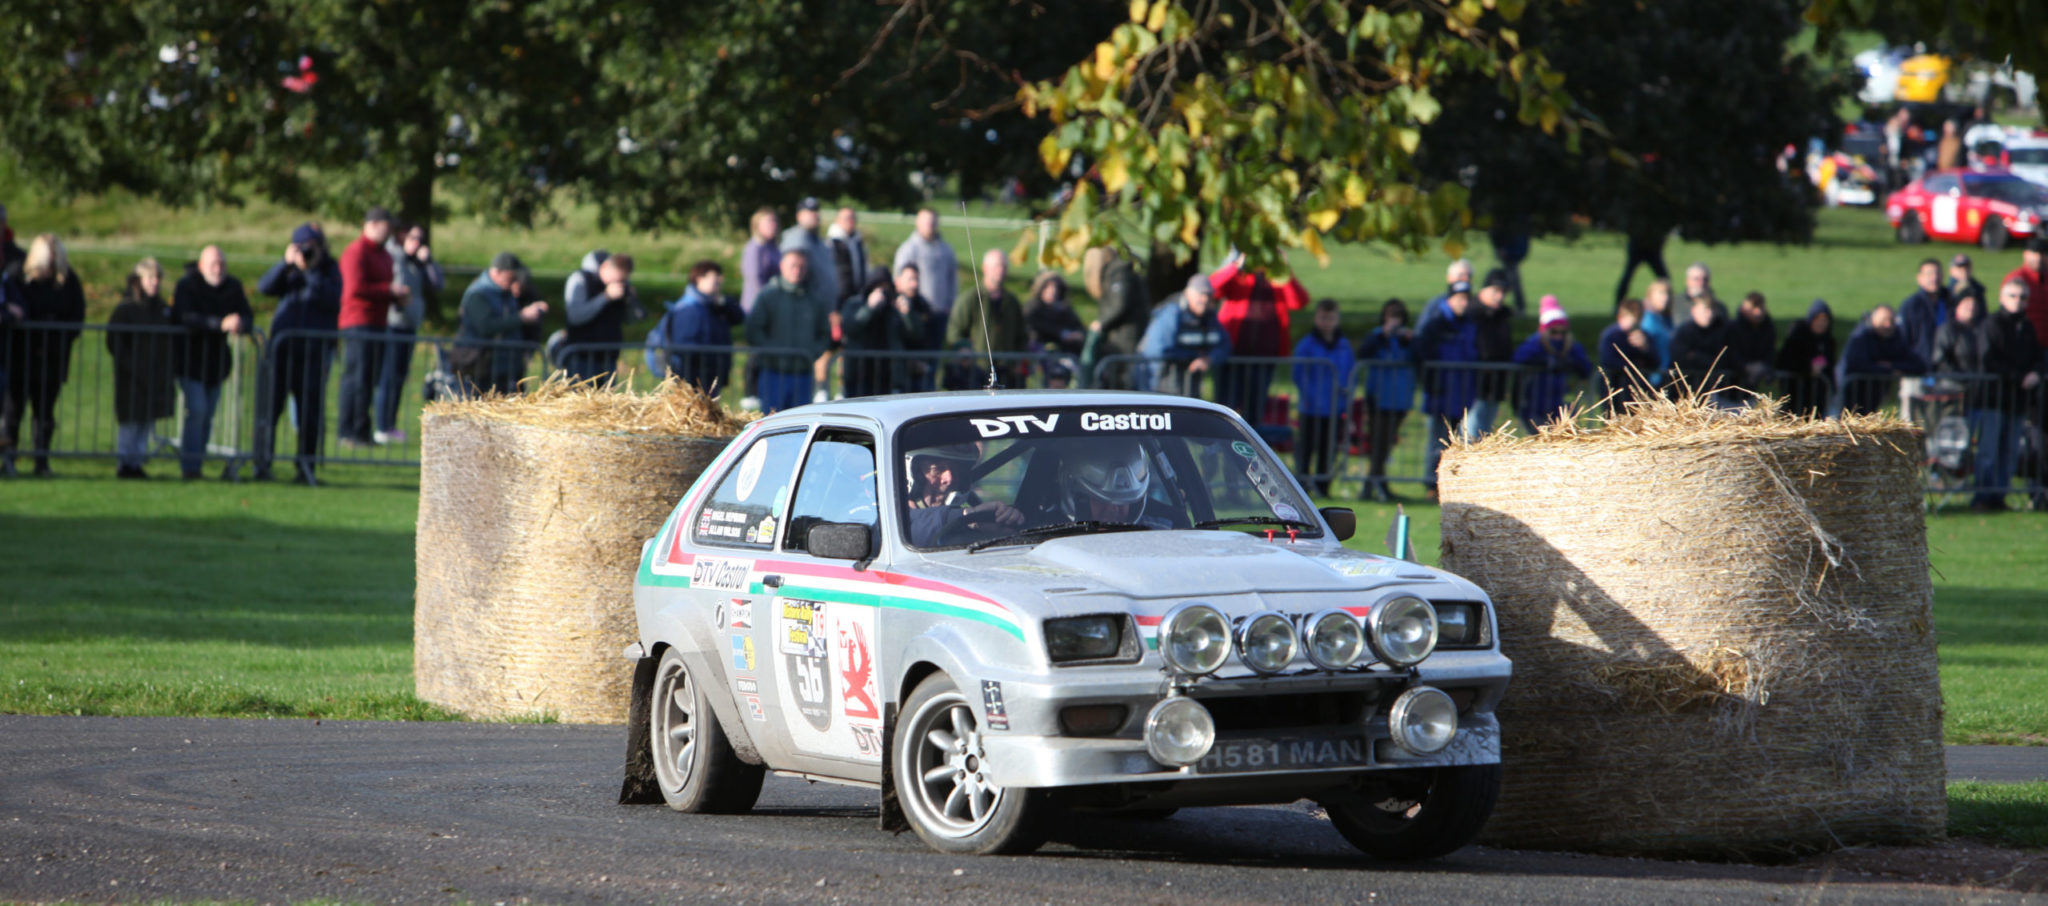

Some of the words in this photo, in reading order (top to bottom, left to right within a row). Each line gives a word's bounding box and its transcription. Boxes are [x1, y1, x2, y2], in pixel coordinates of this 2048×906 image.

[969, 413, 1060, 438] DTV
[1080, 412, 1172, 431] Castrol
[694, 561, 720, 583] DTV
[715, 560, 750, 589] Castrol
[796, 656, 825, 703] 56
[1201, 744, 1280, 769] H581
[1290, 739, 1361, 764] MAN
